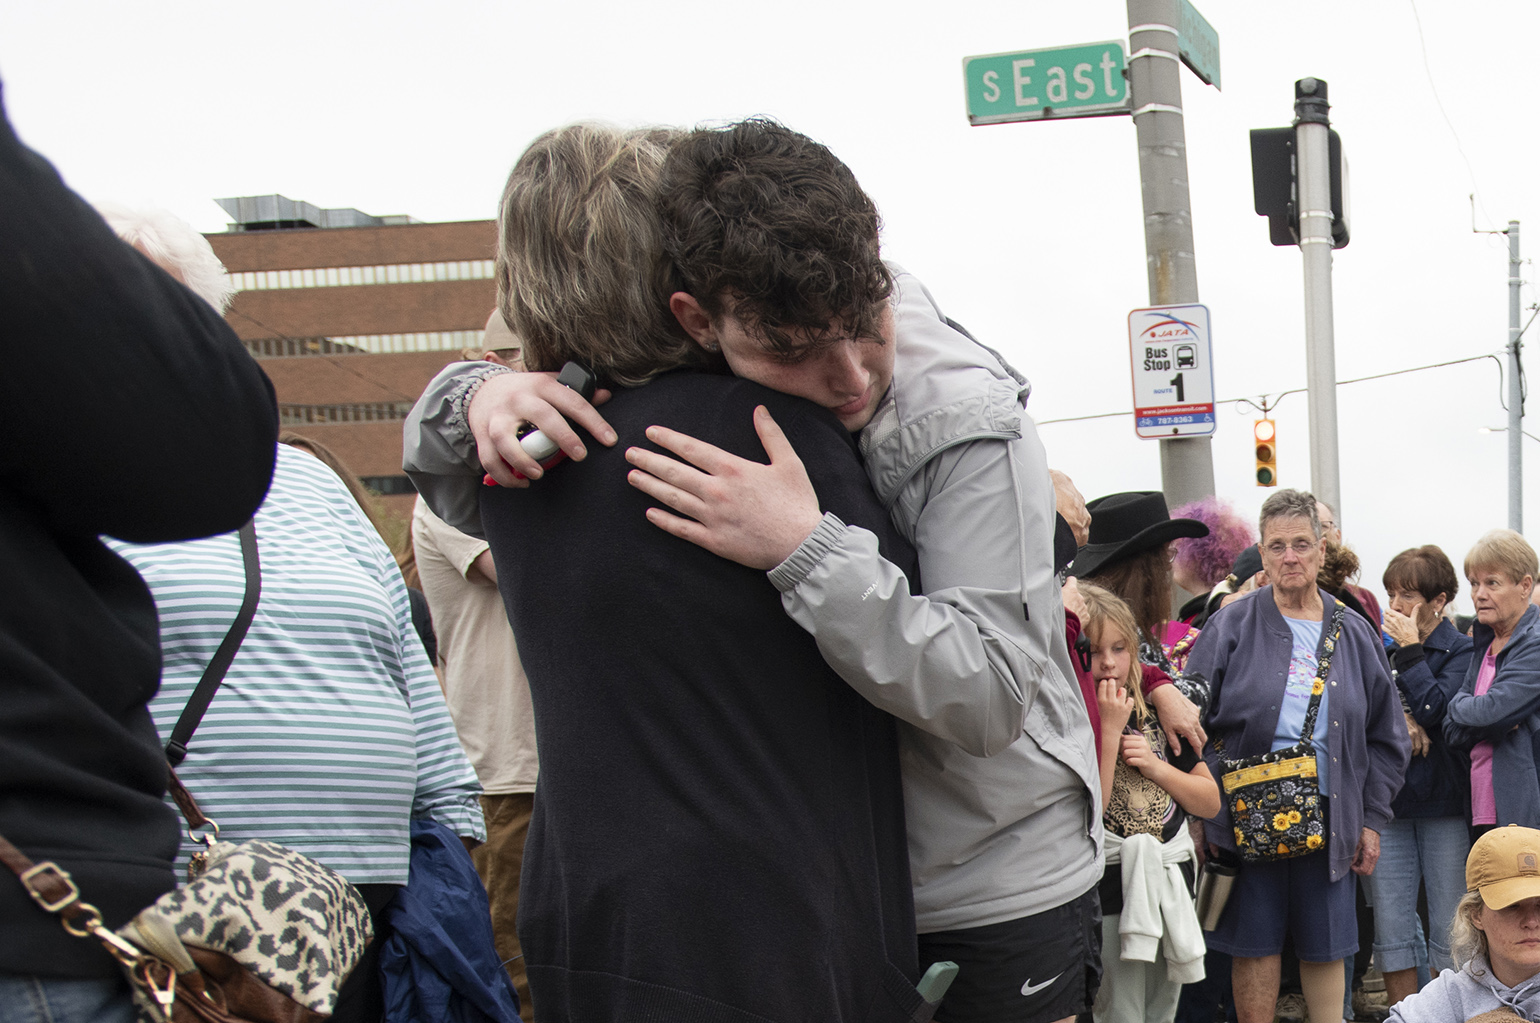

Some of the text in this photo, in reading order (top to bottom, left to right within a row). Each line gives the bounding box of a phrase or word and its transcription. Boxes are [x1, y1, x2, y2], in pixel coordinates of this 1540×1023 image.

[1012, 51, 1118, 107] East
[1158, 329, 1189, 337] JATA
[1145, 347, 1168, 359] Bus
[1144, 359, 1171, 371] Stop
[1170, 372, 1185, 402] 1
